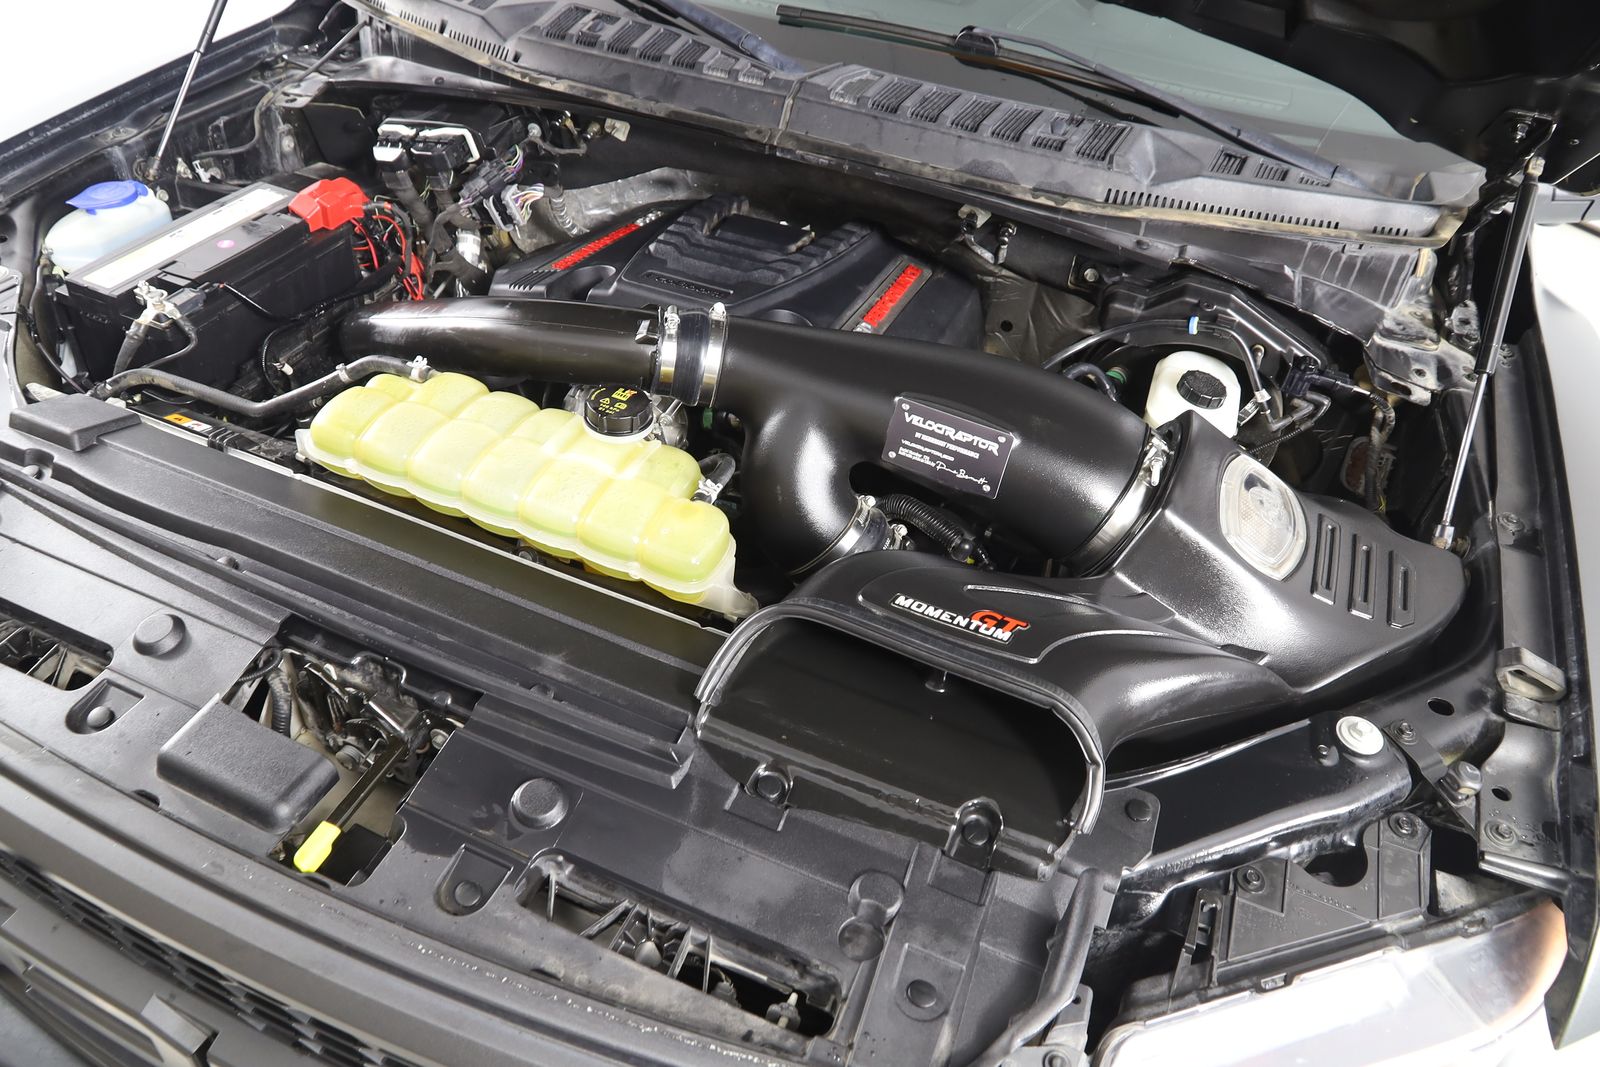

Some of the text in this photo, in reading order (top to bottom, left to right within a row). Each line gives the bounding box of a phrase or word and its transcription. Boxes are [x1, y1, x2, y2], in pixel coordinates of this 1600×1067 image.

[904, 411, 999, 456] VELOCIRAPTOR
[894, 595, 1013, 641] MOMENTUM
[970, 609, 1028, 633] GT
